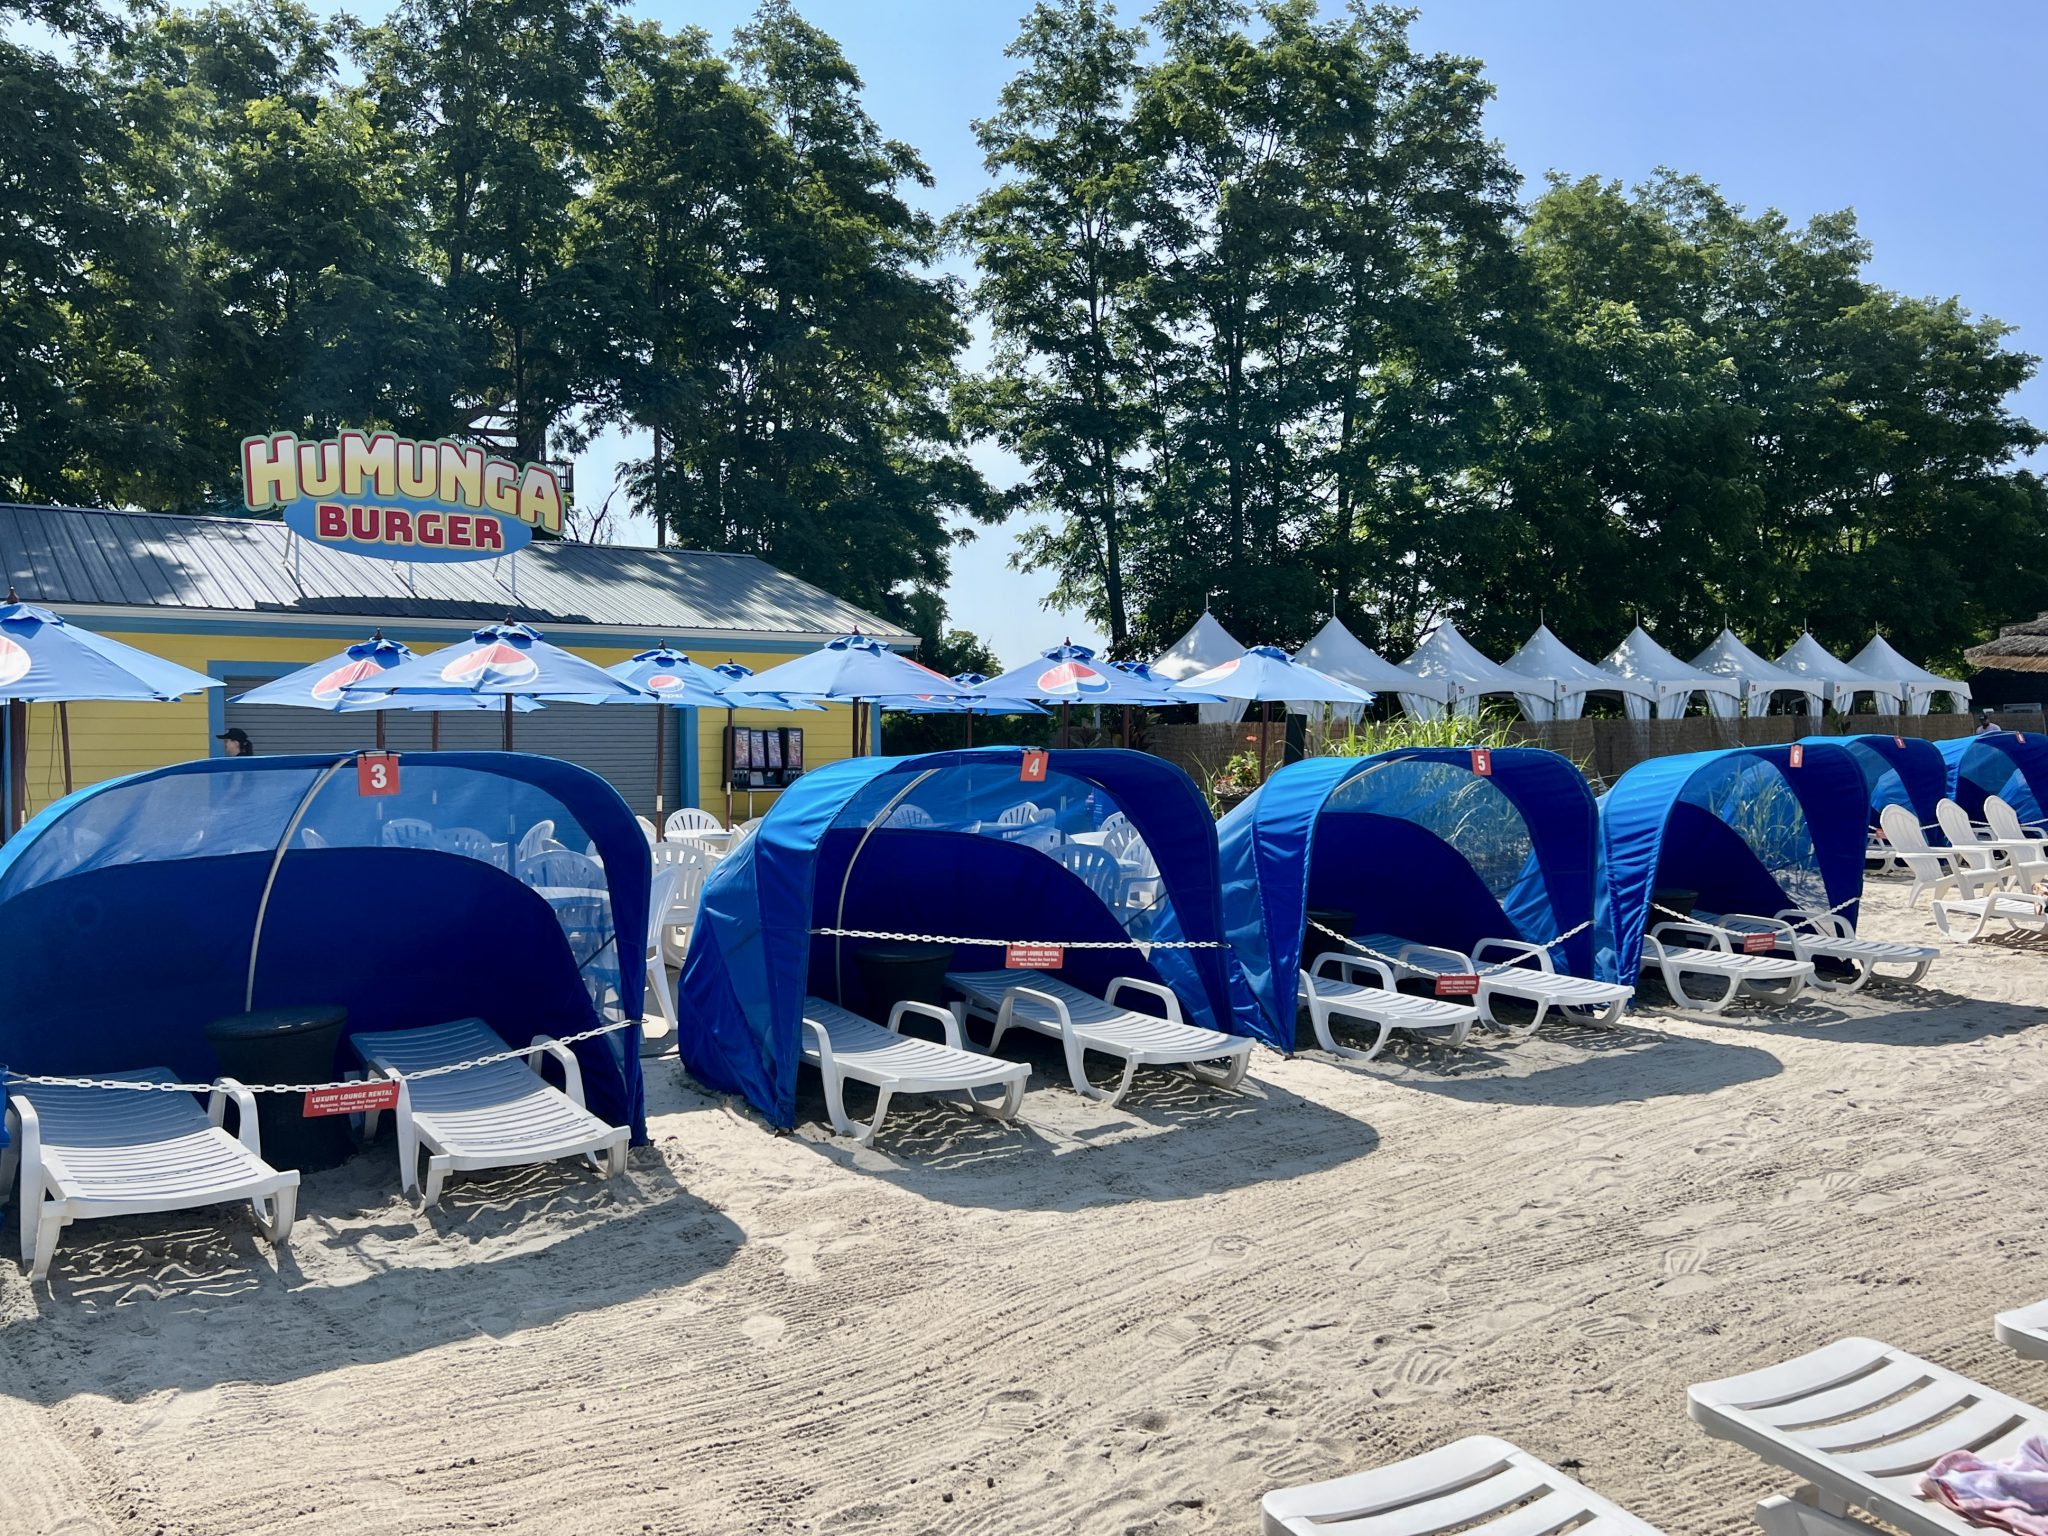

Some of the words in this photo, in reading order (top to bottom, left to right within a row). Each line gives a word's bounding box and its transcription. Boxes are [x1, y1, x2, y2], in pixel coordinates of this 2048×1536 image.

[243, 431, 564, 533] HUMUNGA
[317, 504, 503, 550] BURGER
[1028, 758, 1040, 776] 4
[1477, 755, 1486, 771] 5
[371, 763, 387, 789] 3
[312, 1094, 339, 1104] LUXURY
[340, 1092, 367, 1101] LOUNGE
[368, 1089, 393, 1098] RENTAL
